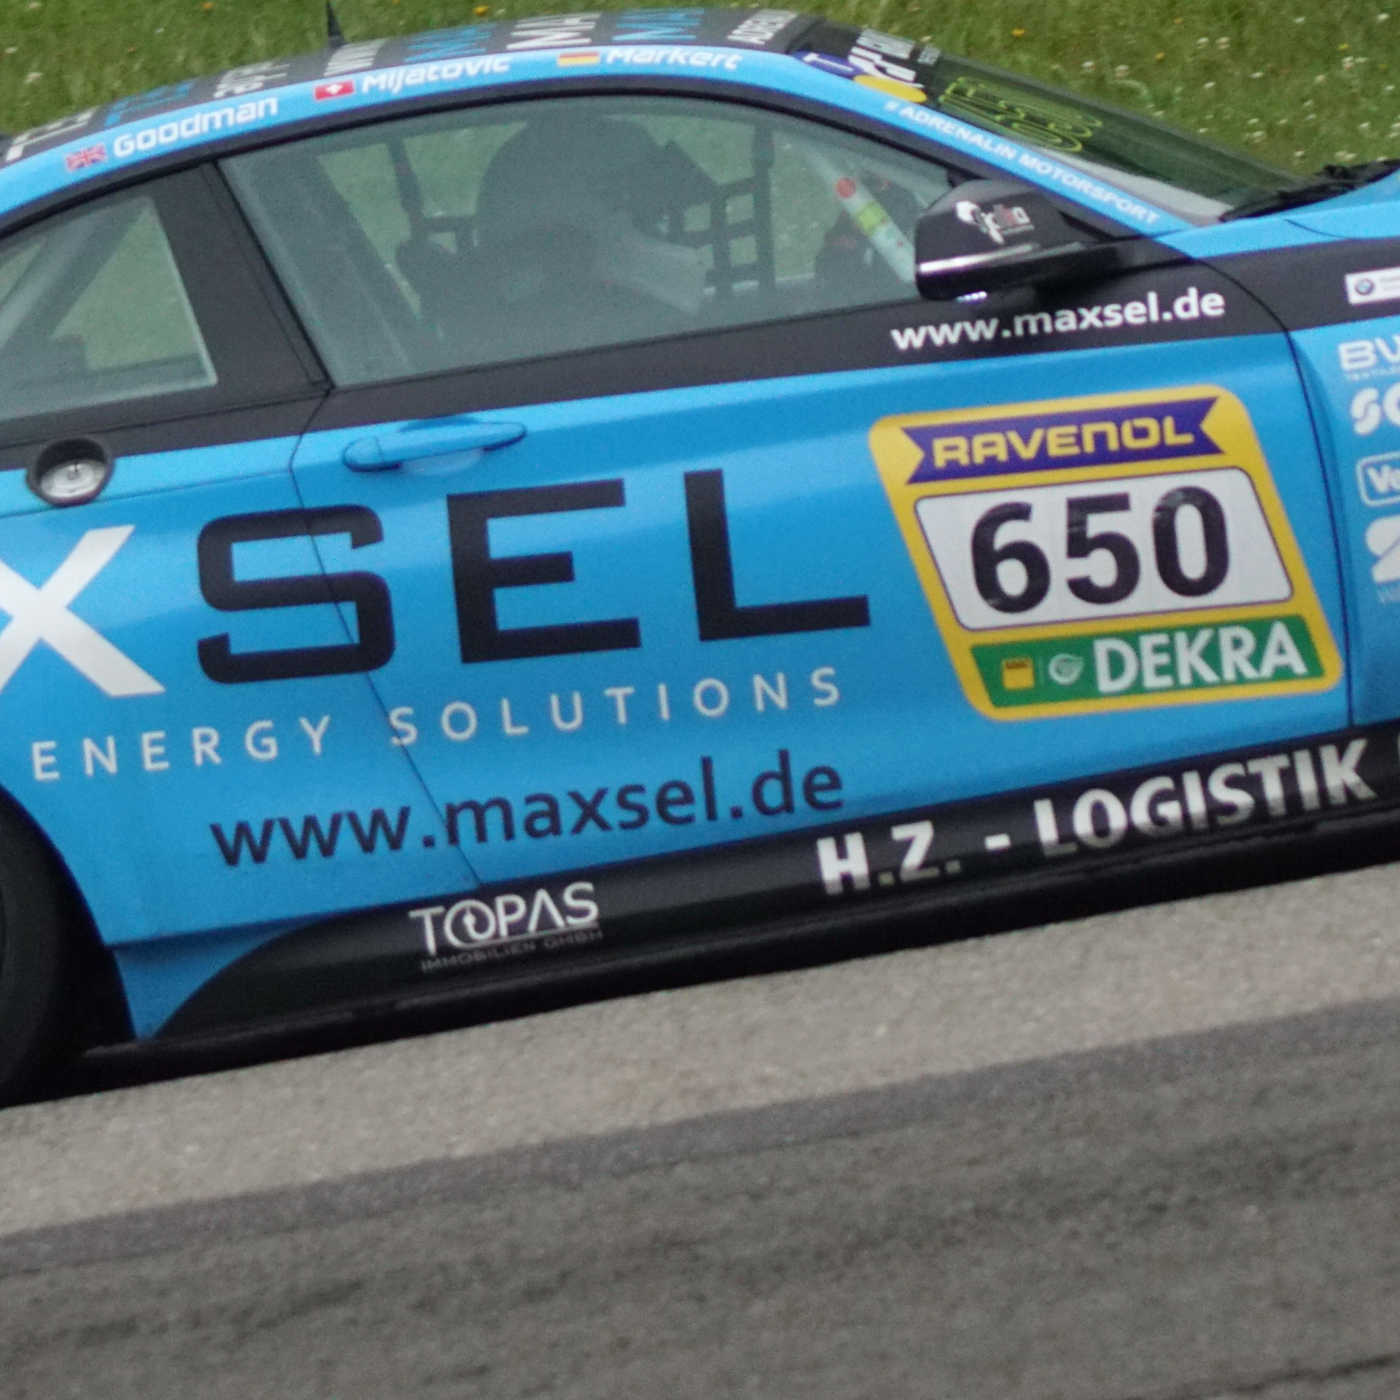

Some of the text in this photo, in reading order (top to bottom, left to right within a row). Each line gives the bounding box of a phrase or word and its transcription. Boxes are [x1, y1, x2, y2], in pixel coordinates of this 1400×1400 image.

[605, 46, 743, 71] Markert
[112, 96, 280, 158] Goodman
[899, 105, 1017, 160] ADRENALIN
[1018, 153, 1161, 224] MOTORSPORT
[890, 288, 1227, 352] www.maxsel.de
[932, 415, 1195, 468] RAVENOL
[969, 485, 1233, 616] 650
[1091, 620, 1310, 695] DEKRA
[30, 665, 844, 783] ENERGY SOLUTIONS
[208, 747, 845, 870] www.maxsel.de
[815, 818, 962, 895] H.Z.
[1032, 737, 1377, 857] LOGISTIK
[407, 881, 600, 956] TOPAS
